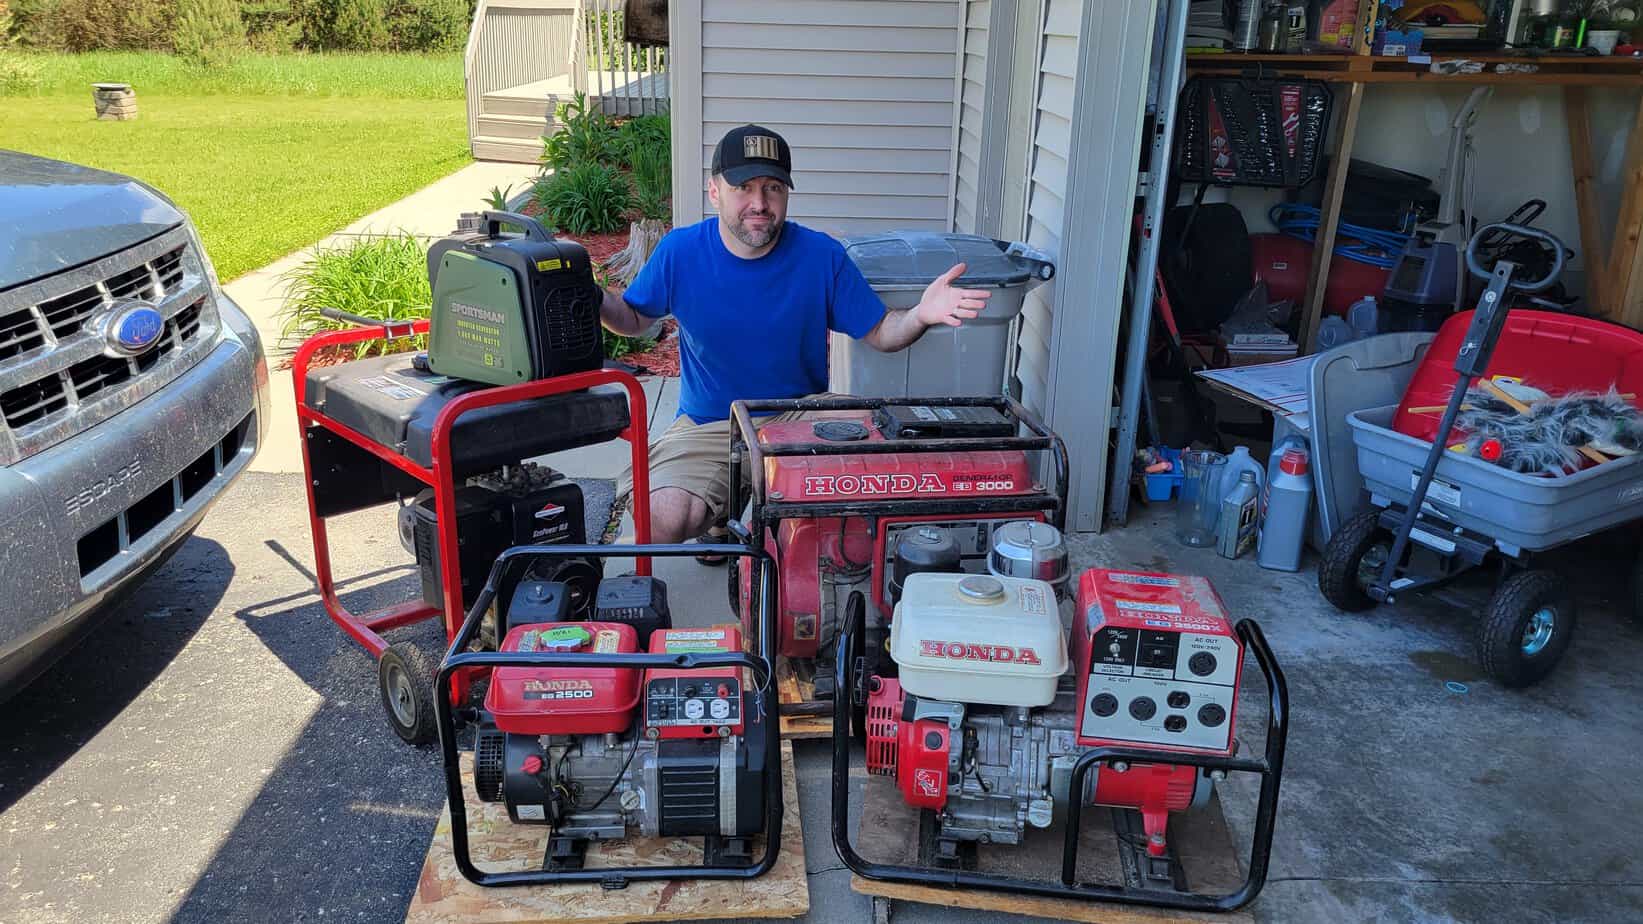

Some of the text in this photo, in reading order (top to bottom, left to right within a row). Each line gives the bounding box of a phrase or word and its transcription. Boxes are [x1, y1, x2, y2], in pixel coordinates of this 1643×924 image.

[450, 302, 505, 325] SPORTSMAN
[805, 472, 946, 496] HONDA
[952, 474, 1013, 482] GENERATOR
[976, 480, 1014, 491] 3000
[65, 459, 142, 516] ESCAPE
[1119, 609, 1219, 626] HONDA
[919, 639, 1042, 666] HONDA
[524, 679, 593, 691] HONDA
[555, 690, 593, 699] 2500
